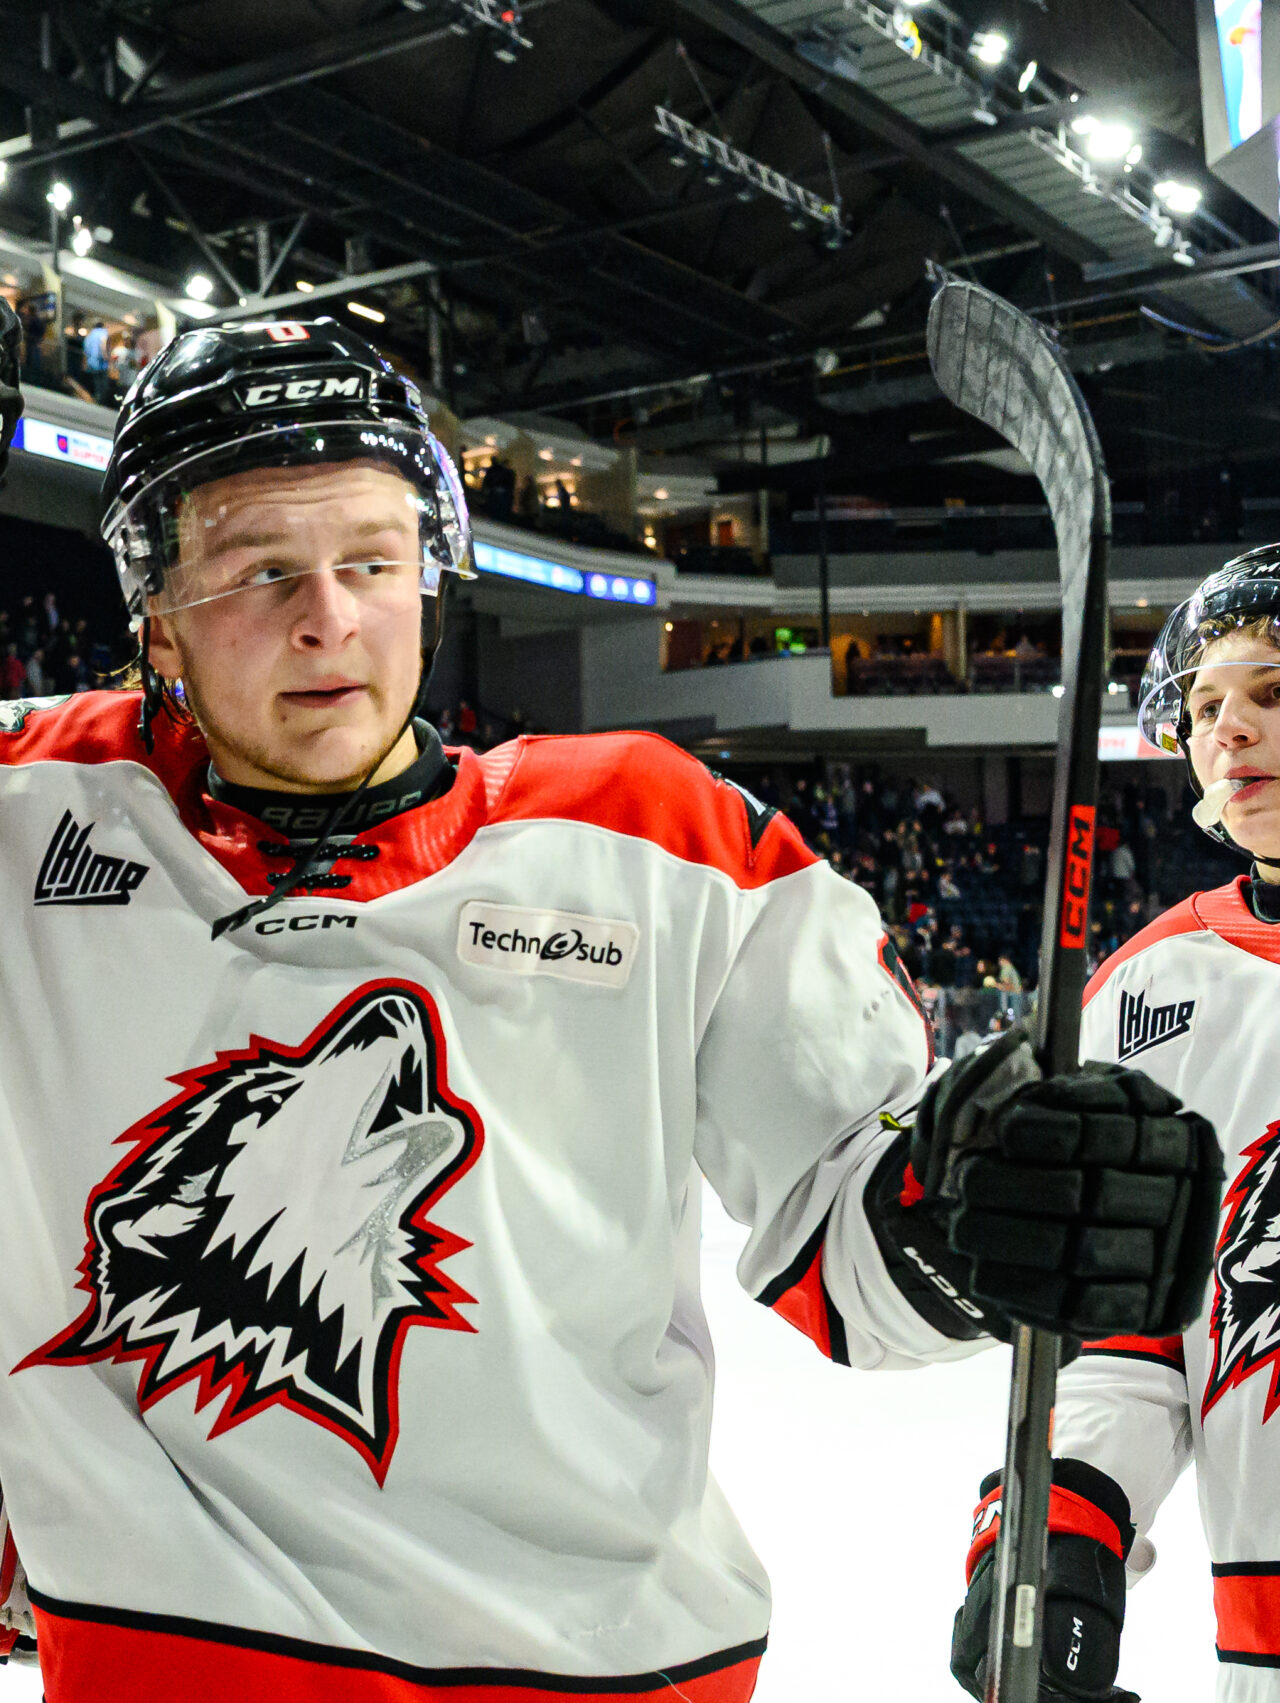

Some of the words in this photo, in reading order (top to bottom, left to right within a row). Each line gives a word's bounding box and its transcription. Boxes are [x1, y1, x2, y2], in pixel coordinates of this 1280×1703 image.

[245, 377, 360, 406] CCM
[1066, 817, 1090, 937] CCM
[255, 915, 358, 936] CCM
[903, 1246, 984, 1319] CCM
[1067, 1616, 1083, 1671] CCM
